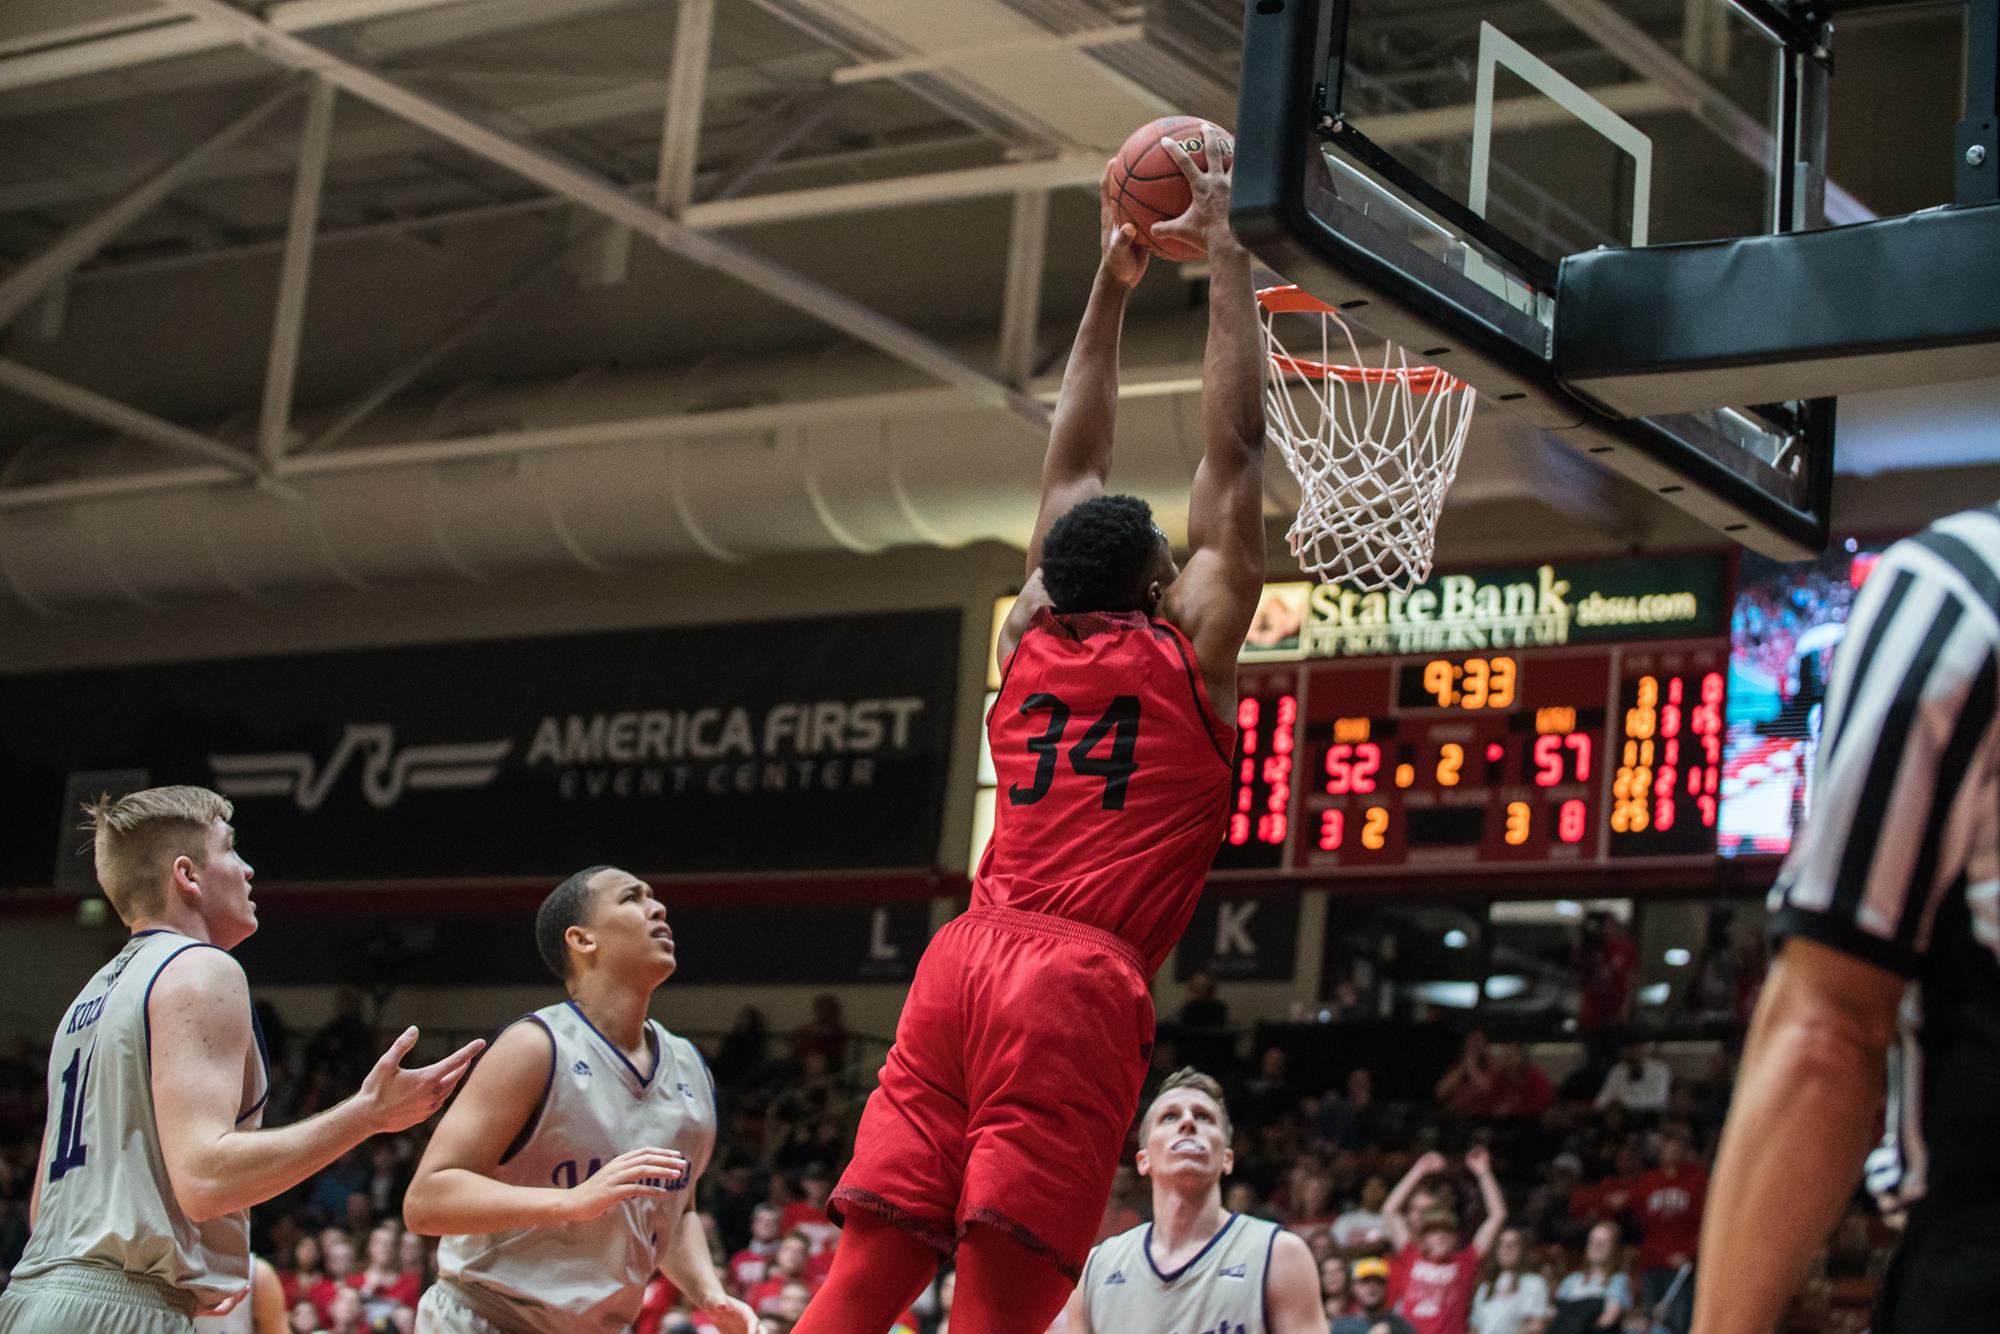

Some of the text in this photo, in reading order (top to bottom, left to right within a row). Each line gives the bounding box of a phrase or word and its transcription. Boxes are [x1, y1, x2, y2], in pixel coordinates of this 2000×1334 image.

[1311, 565, 1570, 626] State Bank
[1423, 656, 1517, 710] 9:33
[527, 696, 925, 765] AMERICA FIRST
[1009, 692, 1141, 811] 34
[559, 759, 875, 799] EVENT CENTER
[1326, 733, 1592, 794] 52 2 57
[1319, 808, 1344, 850] 3
[1361, 806, 1389, 849] 2
[1505, 801, 1530, 845] 3
[870, 907, 901, 960] L
[1216, 900, 1260, 957] K
[49, 1034, 97, 1184] 11
